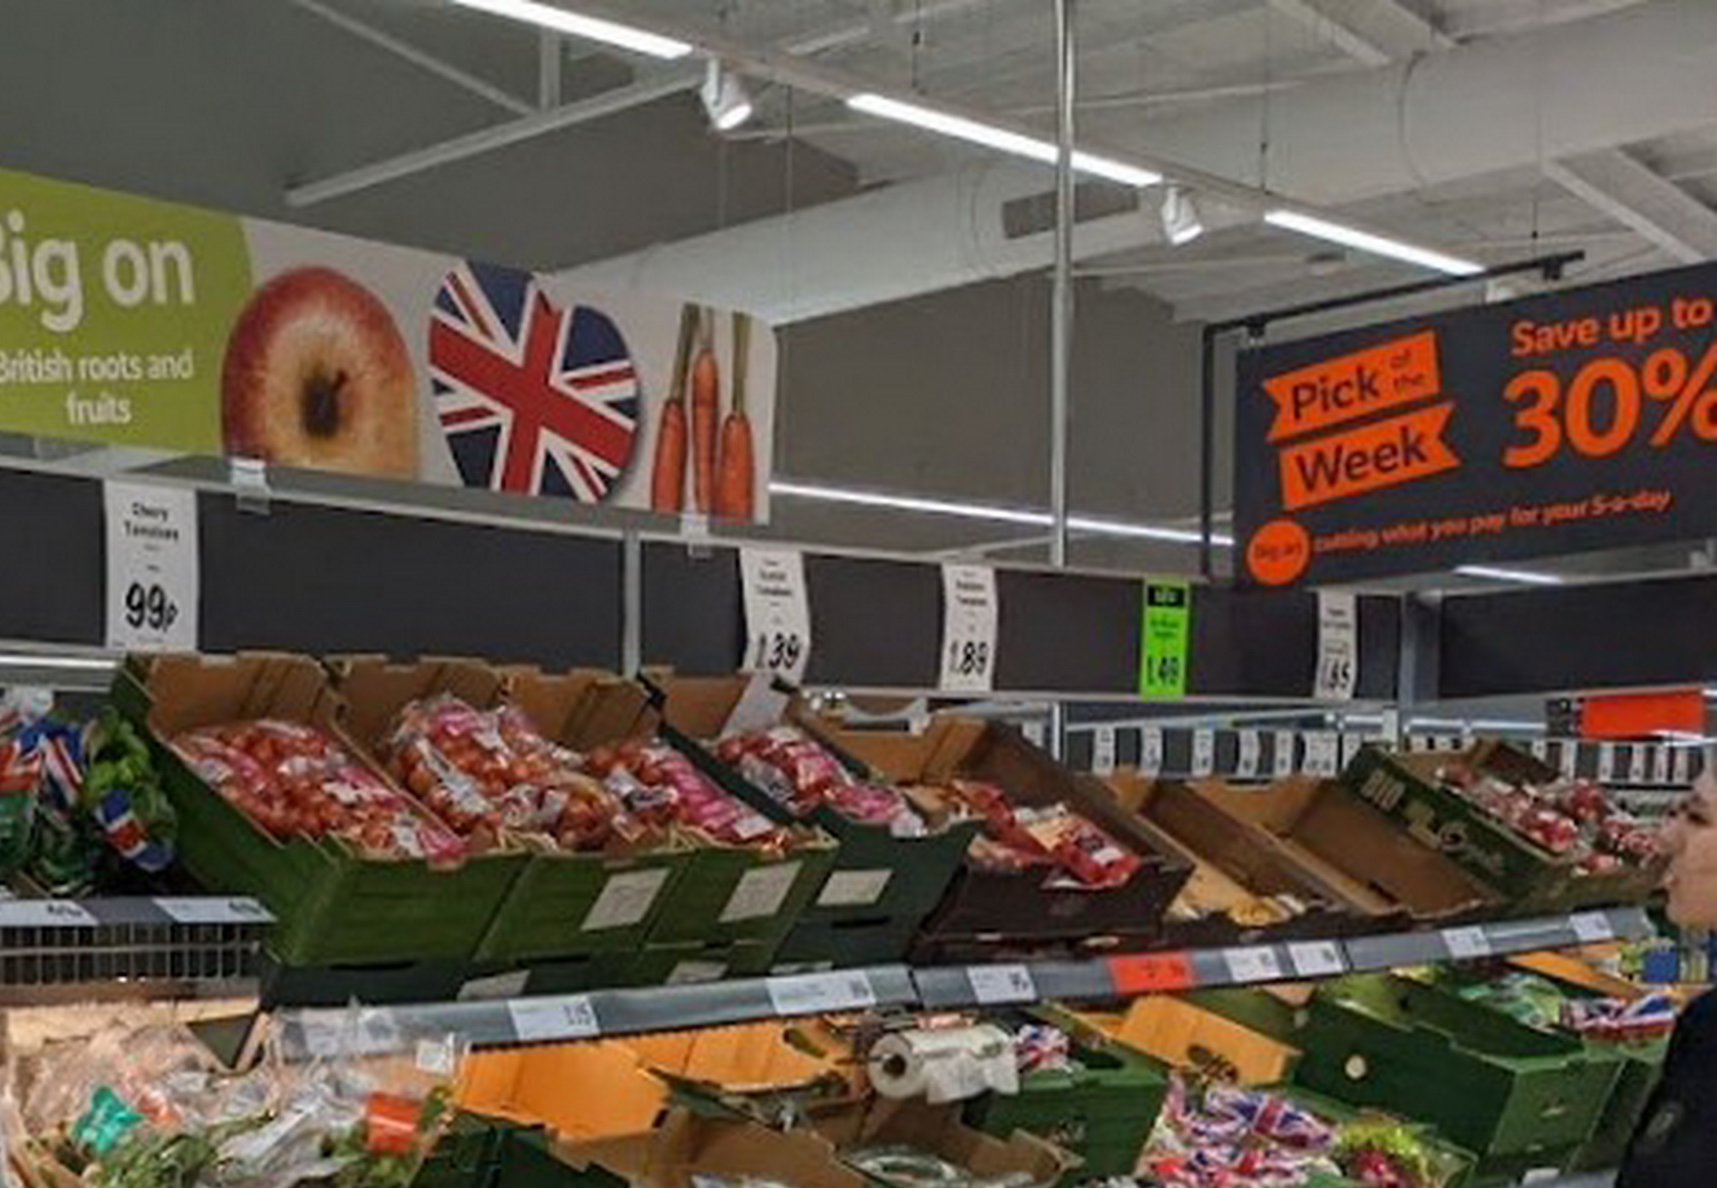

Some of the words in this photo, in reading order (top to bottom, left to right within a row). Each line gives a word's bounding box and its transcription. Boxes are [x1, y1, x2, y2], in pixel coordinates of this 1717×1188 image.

[102, 238, 196, 306] on
[1511, 318, 1600, 356] Save
[1609, 305, 1662, 343] up
[1672, 297, 1713, 329] to
[79, 351, 143, 381] roots
[147, 349, 194, 380] and
[1292, 364, 1380, 420] Pick
[66, 390, 132, 424] fruits
[1502, 340, 1717, 469] 30%
[1295, 424, 1429, 493] Week
[1382, 522, 1428, 545] what
[1429, 518, 1466, 542] you
[1469, 512, 1506, 535] pay
[1510, 505, 1539, 525] for
[1541, 502, 1587, 525] your
[125, 581, 179, 634] 99p
